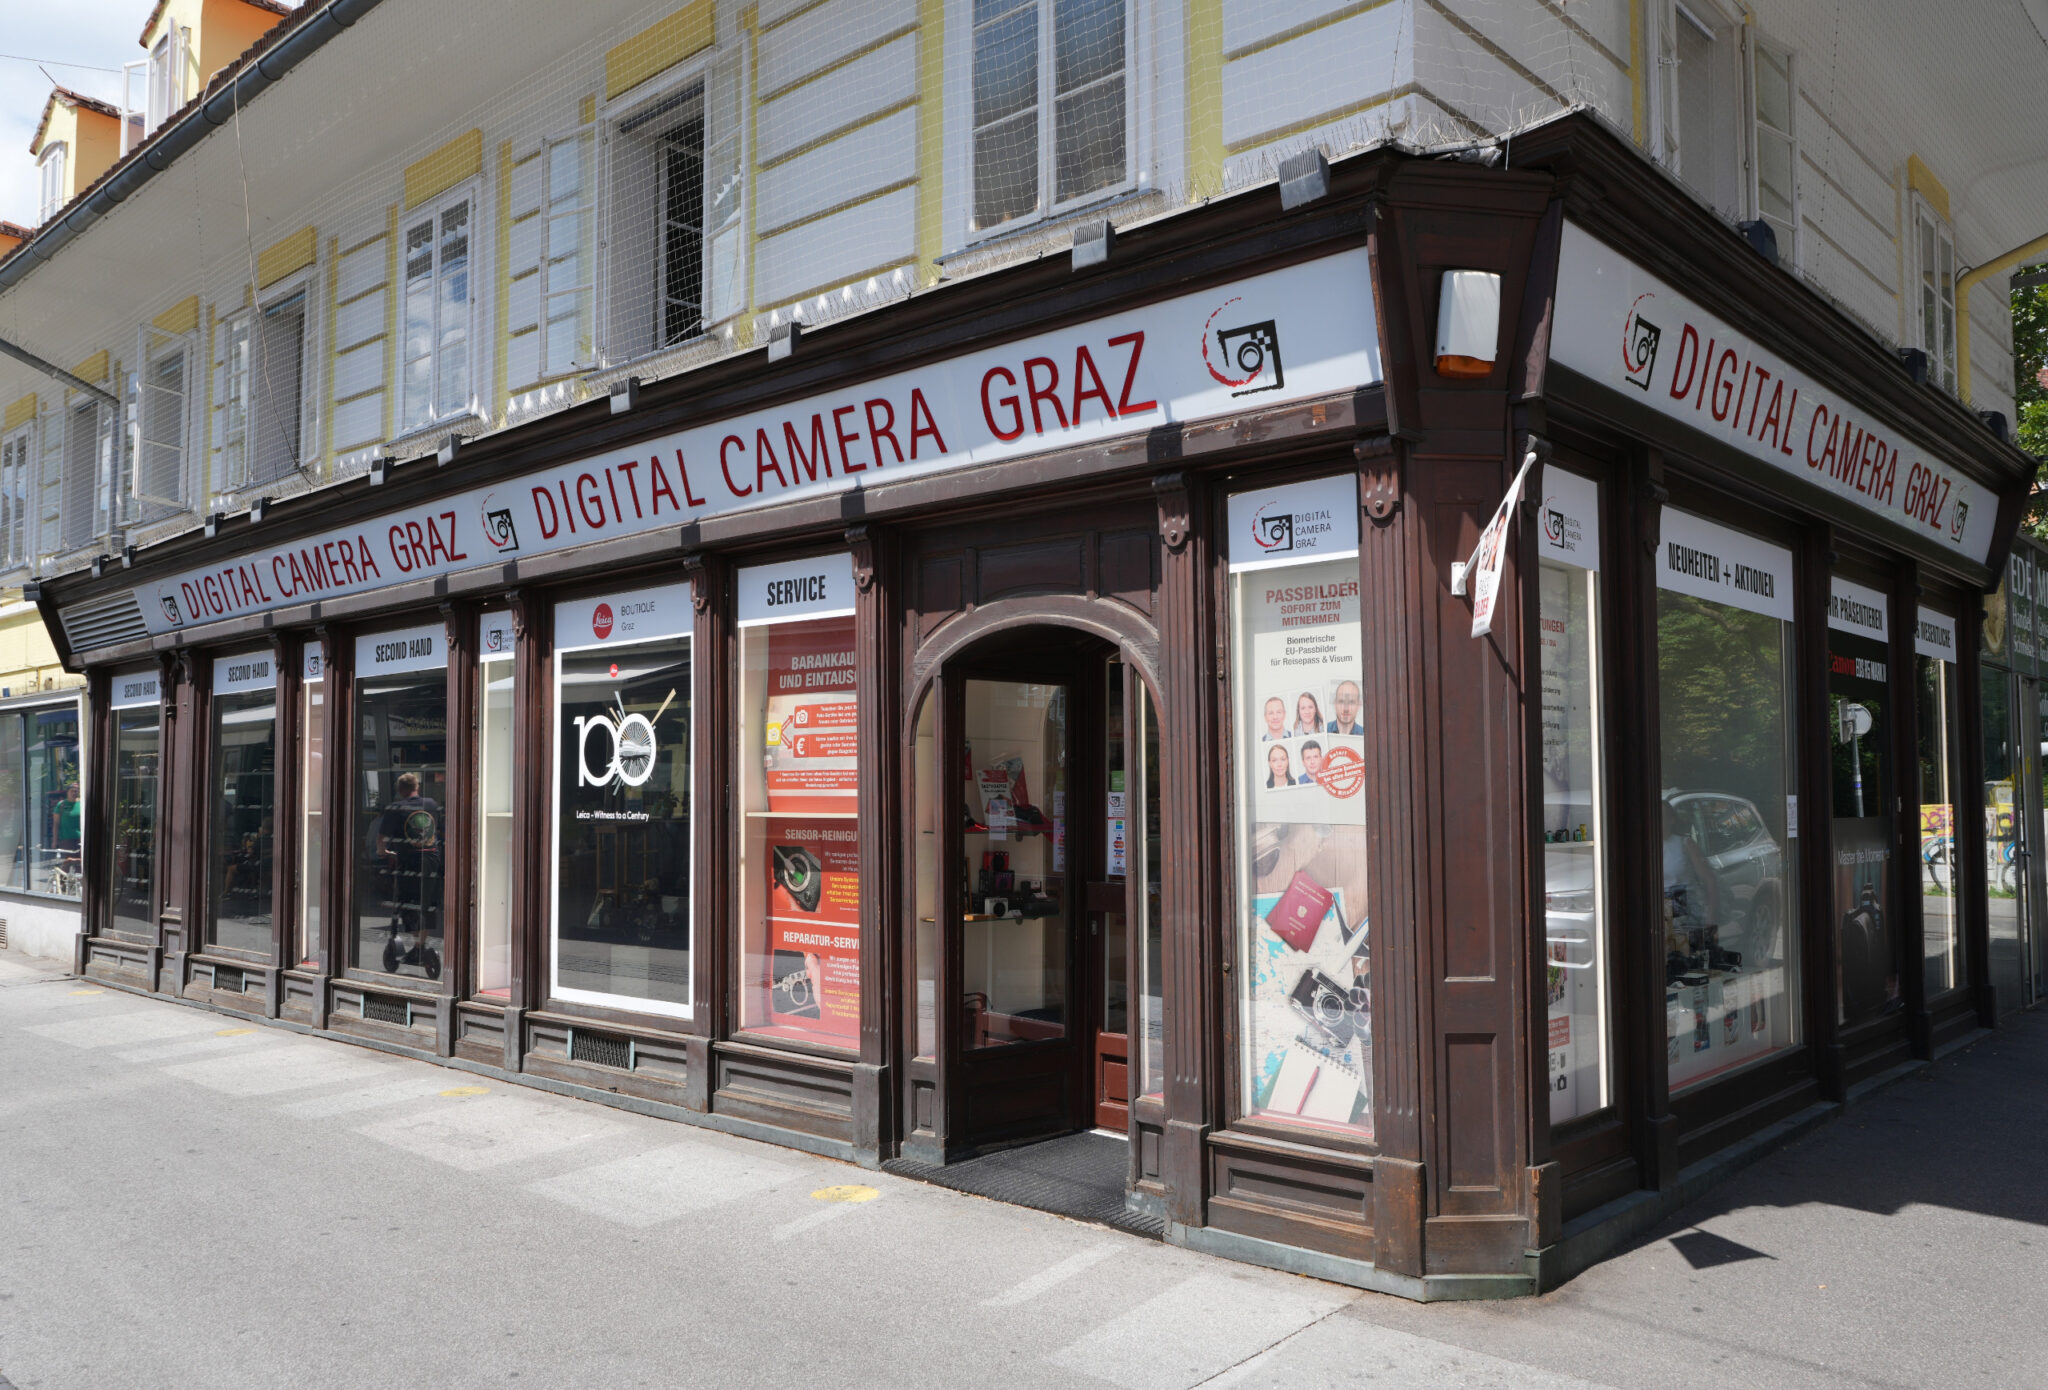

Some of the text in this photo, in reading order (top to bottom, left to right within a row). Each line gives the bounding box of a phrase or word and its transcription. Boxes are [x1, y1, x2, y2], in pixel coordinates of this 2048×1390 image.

[1669, 322, 1951, 530] DIGITAL CAMERA GRAZ
[533, 331, 1158, 540] DIGITAL CAMERA GRAZ
[1295, 510, 1332, 523] DIGITAL
[1295, 523, 1332, 536] CAMERA
[1296, 537, 1317, 548] GRAZ
[181, 511, 467, 620] DIGITAL CAMERA GRAZ
[1668, 542, 1720, 583] NEUHEITEN
[1734, 562, 1774, 598] AKTIONEN
[767, 575, 827, 606] SERVICE
[1265, 582, 1359, 604] PASSBILDER
[621, 602, 656, 616] BOUTIQUE
[1280, 600, 1341, 615] SOFORT ZUM
[1840, 596, 1883, 631] PRÄSENTIEREN
[593, 611, 613, 628] Leica
[621, 622, 635, 631] Graz
[1281, 613, 1340, 626] MITNEHMEN
[1286, 634, 1336, 645] Biometrische
[375, 637, 432, 663] SECOND HAND
[1285, 645, 1337, 656] EU-Passbilder
[791, 651, 857, 671] BARANKAU
[1270, 657, 1281, 667] für
[1282, 656, 1320, 666] Reisepass
[1329, 655, 1353, 663] Visum
[228, 661, 269, 682] SECOND HAND
[779, 669, 857, 689] UND EINTAUS
[124, 680, 157, 698] SECOND HAND
[576, 810, 590, 819] Leica
[594, 810, 615, 819] Witness
[616, 811, 622, 819] to
[627, 811, 649, 822] Century
